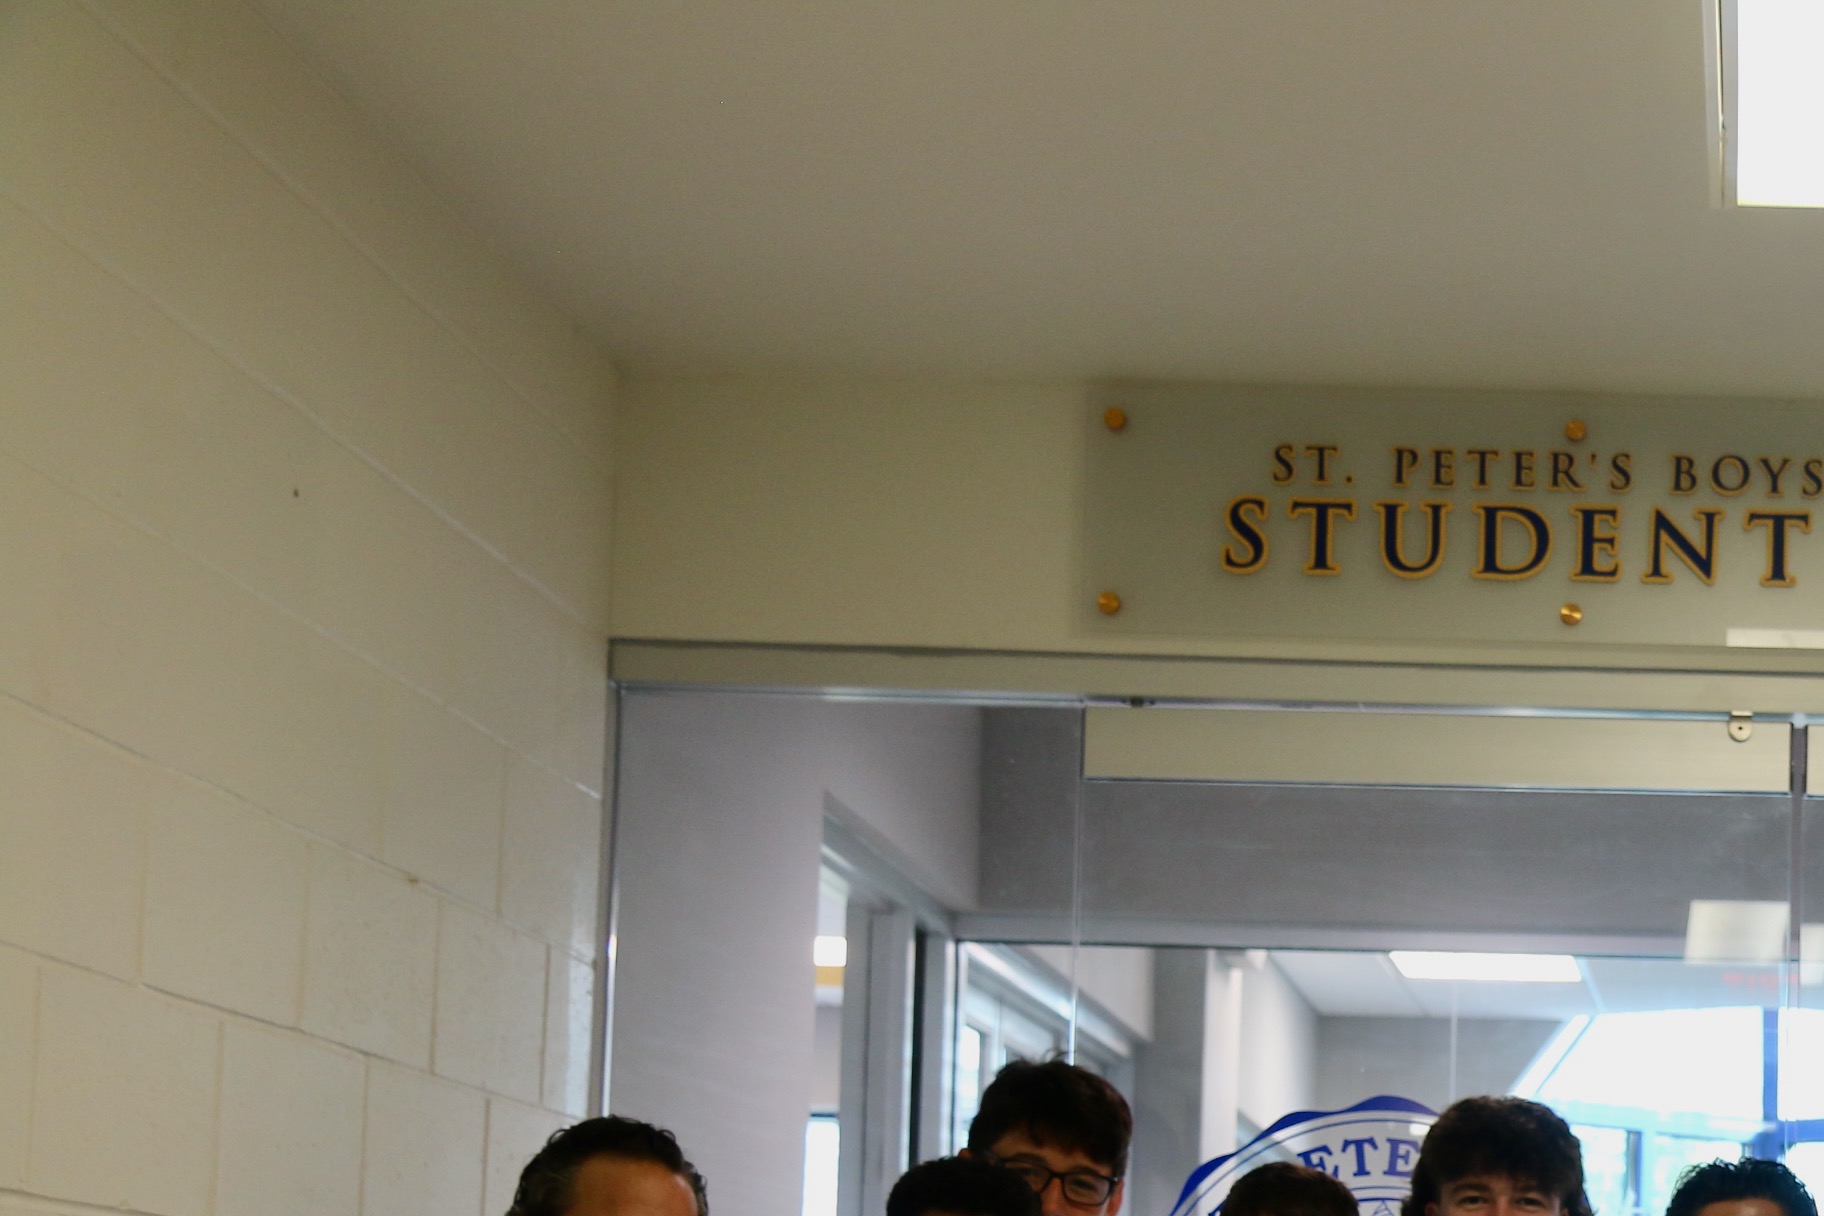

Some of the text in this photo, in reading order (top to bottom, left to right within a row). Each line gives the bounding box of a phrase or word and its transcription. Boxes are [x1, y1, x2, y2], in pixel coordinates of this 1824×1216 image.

[1270, 443, 1353, 485] ST.
[1393, 446, 1632, 492] PETER'S
[1670, 452, 1824, 498] BOYS
[1221, 496, 1811, 588] STUDENT
